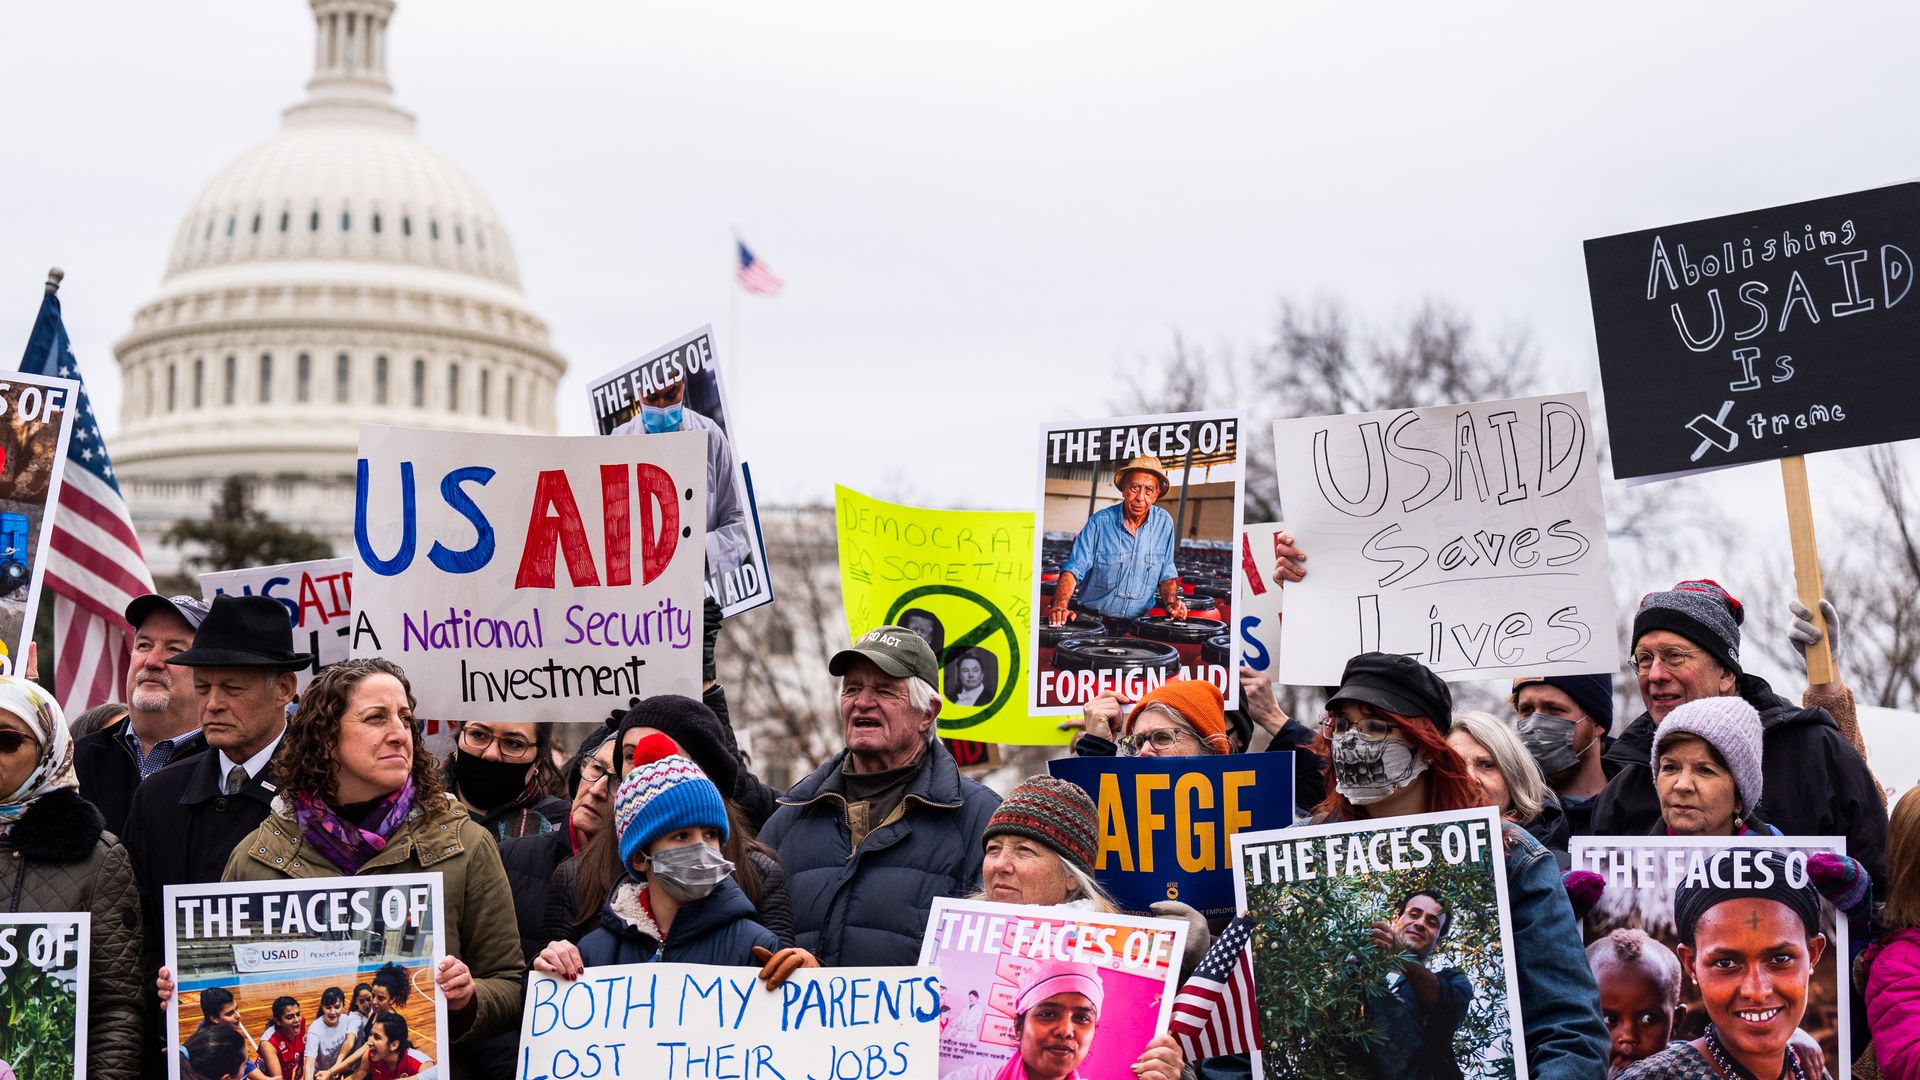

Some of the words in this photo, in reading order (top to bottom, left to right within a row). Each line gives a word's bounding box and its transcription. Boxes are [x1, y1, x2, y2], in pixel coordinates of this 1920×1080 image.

[1647, 220, 1857, 300] Abolishing
[1671, 244, 1914, 353] USAID
[594, 376, 632, 418] THE
[630, 351, 684, 401] FACES
[686, 337, 711, 375] OF
[1730, 347, 1795, 392] Is
[18, 386, 64, 424] OF
[1685, 400, 1846, 462] Xtreme
[1049, 431, 1102, 464] THE
[1109, 424, 1192, 460] FACES
[1199, 421, 1236, 454] OF
[1313, 401, 1586, 518] USAID
[1362, 519, 1591, 588] Saves
[724, 563, 758, 605] AID
[353, 611, 382, 650] A
[403, 607, 544, 651] National
[565, 598, 692, 649] Security
[879, 634, 902, 647] ACT
[1358, 594, 1592, 668] Lives
[461, 656, 645, 703] Investment
[1095, 770, 1257, 873] AFGE
[1245, 840, 1317, 886] THE
[1325, 827, 1433, 878] FACES
[1440, 822, 1488, 866] OF
[1586, 851, 1656, 889] THE
[1667, 850, 1775, 890] FACES
[178, 896, 251, 938] THE
[262, 890, 372, 935] FACES
[381, 888, 429, 930] OF
[28, 928, 75, 967] OF
[262, 949, 299, 961] USAID
[940, 912, 1007, 955] THE
[1011, 919, 1117, 965] FACES
[1123, 930, 1172, 971] OF
[531, 974, 656, 1036] BOTH
[679, 974, 757, 1030] MY
[780, 976, 940, 1031] PARENTS
[522, 1043, 625, 1080] LOST
[657, 1042, 786, 1080] THEIR
[808, 1042, 910, 1080] JOBS
